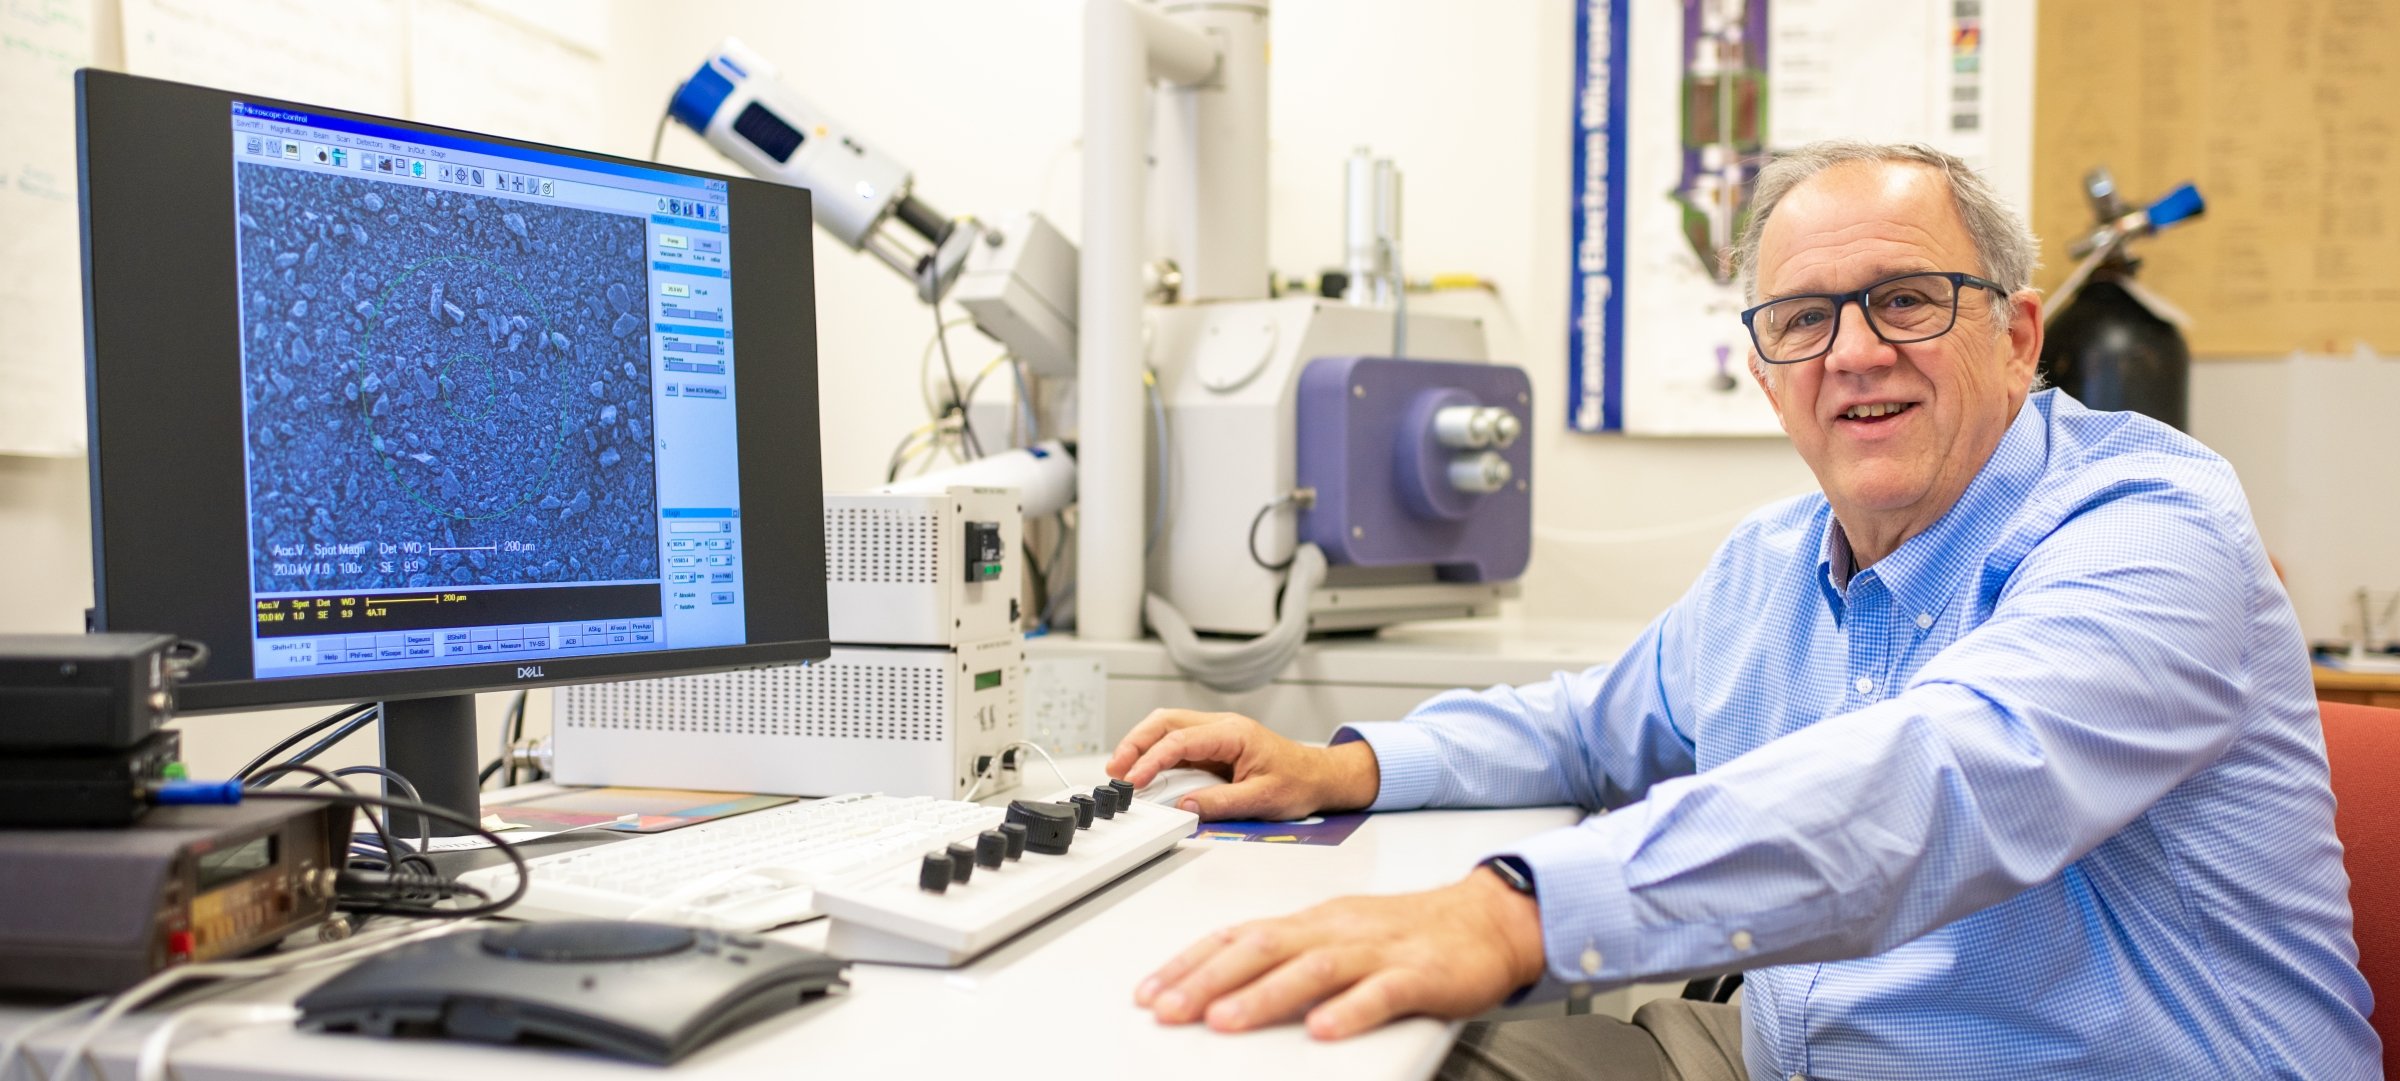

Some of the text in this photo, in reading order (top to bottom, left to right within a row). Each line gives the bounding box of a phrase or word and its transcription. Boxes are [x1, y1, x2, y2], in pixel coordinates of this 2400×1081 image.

[244, 106, 308, 124] Microscope Control
[270, 124, 308, 136] Magnification
[336, 134, 351, 143] Scan
[356, 137, 384, 149] Detectors
[430, 149, 447, 159] Stage
[1577, 0, 1611, 431] Scanning Electron Microsc
[273, 543, 304, 556] Acc.V
[314, 544, 337, 558] Spot
[338, 543, 366, 558] Magn
[380, 542, 397, 554] Det
[403, 541, 422, 554] WD
[504, 540, 520, 552] 200
[273, 563, 297, 576] 20.0
[298, 562, 312, 576] kV
[339, 562, 363, 574] 100x
[381, 561, 395, 573] SE
[403, 560, 419, 573] 9.9
[292, 599, 310, 609] Spot
[316, 598, 331, 607] Det
[341, 597, 356, 606] WD
[443, 593, 456, 602] 200
[293, 611, 305, 620] 1.0
[317, 610, 329, 619] SE
[477, 643, 492, 651] Blank
[501, 642, 522, 650] Measure
[324, 653, 339, 661] Help
[517, 665, 545, 678] DELL
